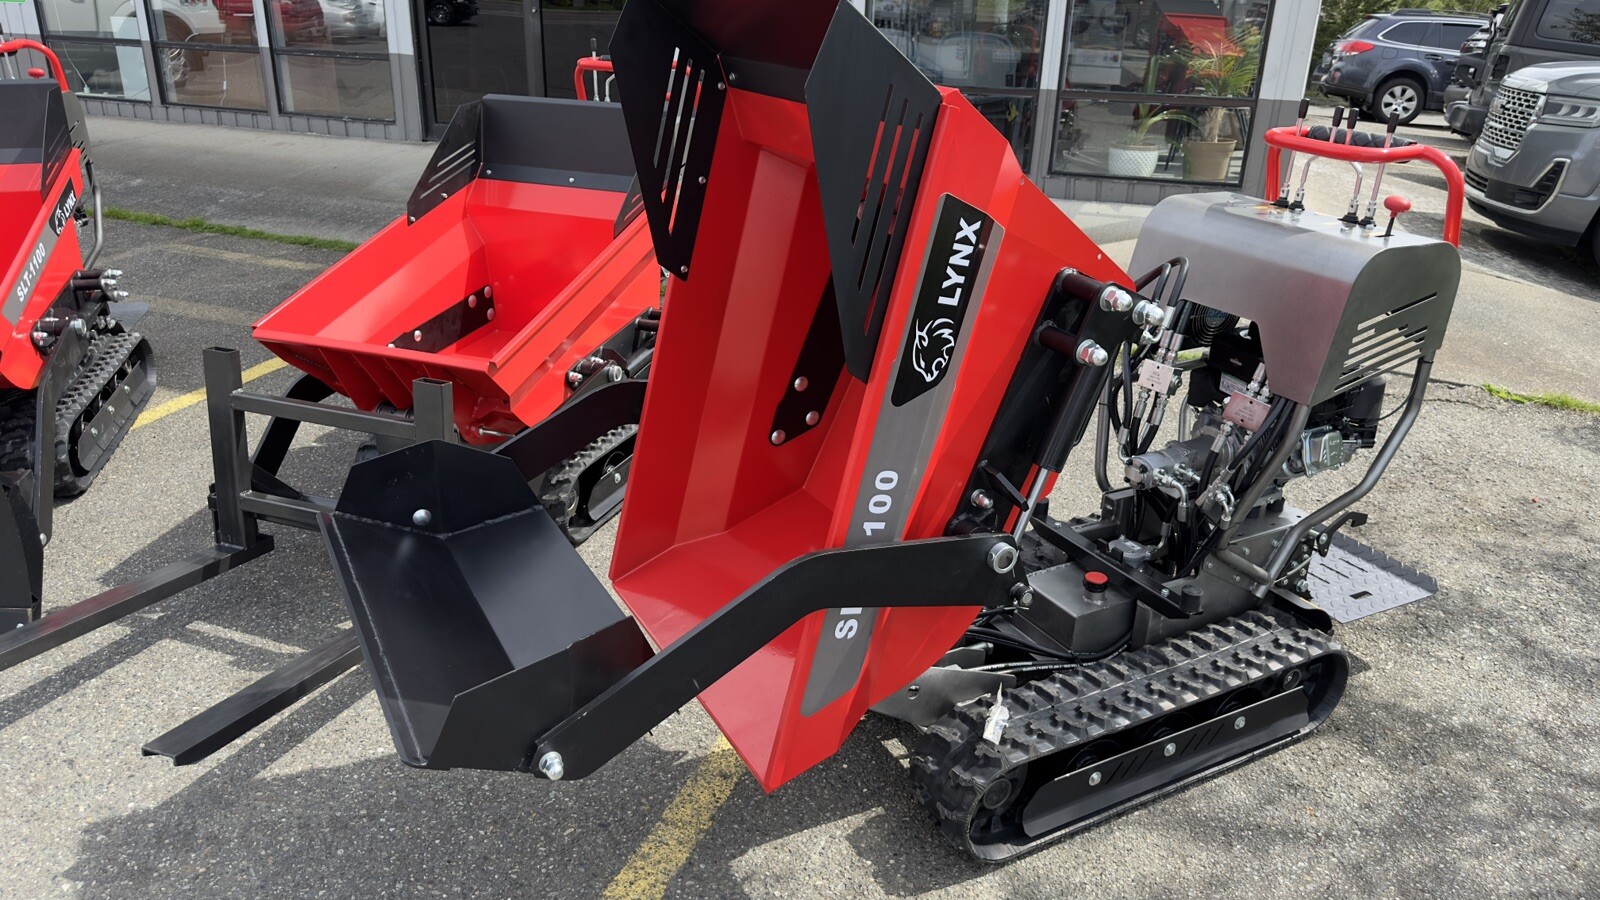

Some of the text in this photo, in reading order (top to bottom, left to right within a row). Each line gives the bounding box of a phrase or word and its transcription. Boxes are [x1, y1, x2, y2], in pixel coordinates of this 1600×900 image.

[63, 190, 76, 220] LYNX
[17, 242, 46, 302] SLT-1100
[938, 217, 981, 306] LYNX
